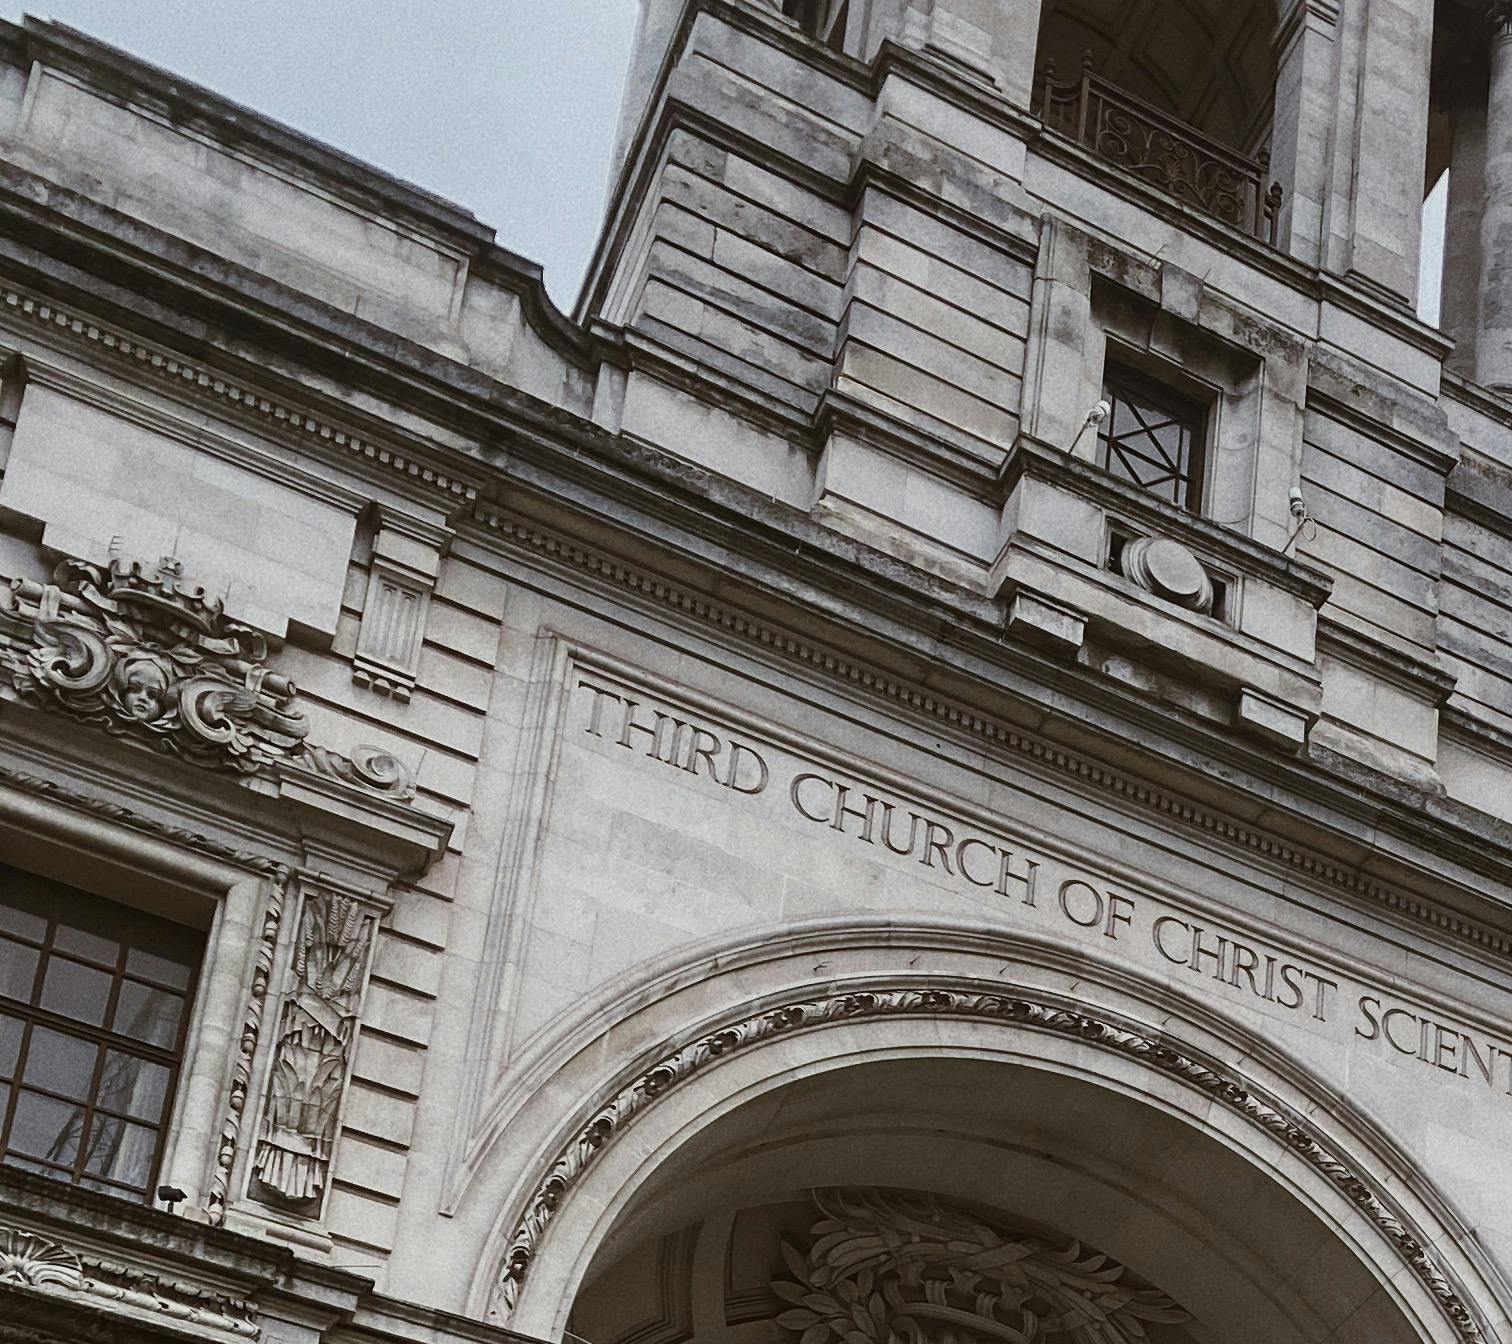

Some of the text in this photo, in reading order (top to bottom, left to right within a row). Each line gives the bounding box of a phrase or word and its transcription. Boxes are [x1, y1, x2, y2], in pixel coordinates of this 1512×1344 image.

[578, 681, 769, 795] THIRD
[790, 772, 1040, 908] CHURCH
[1058, 878, 1136, 940] OF
[1151, 914, 1338, 1023] CHRIST
